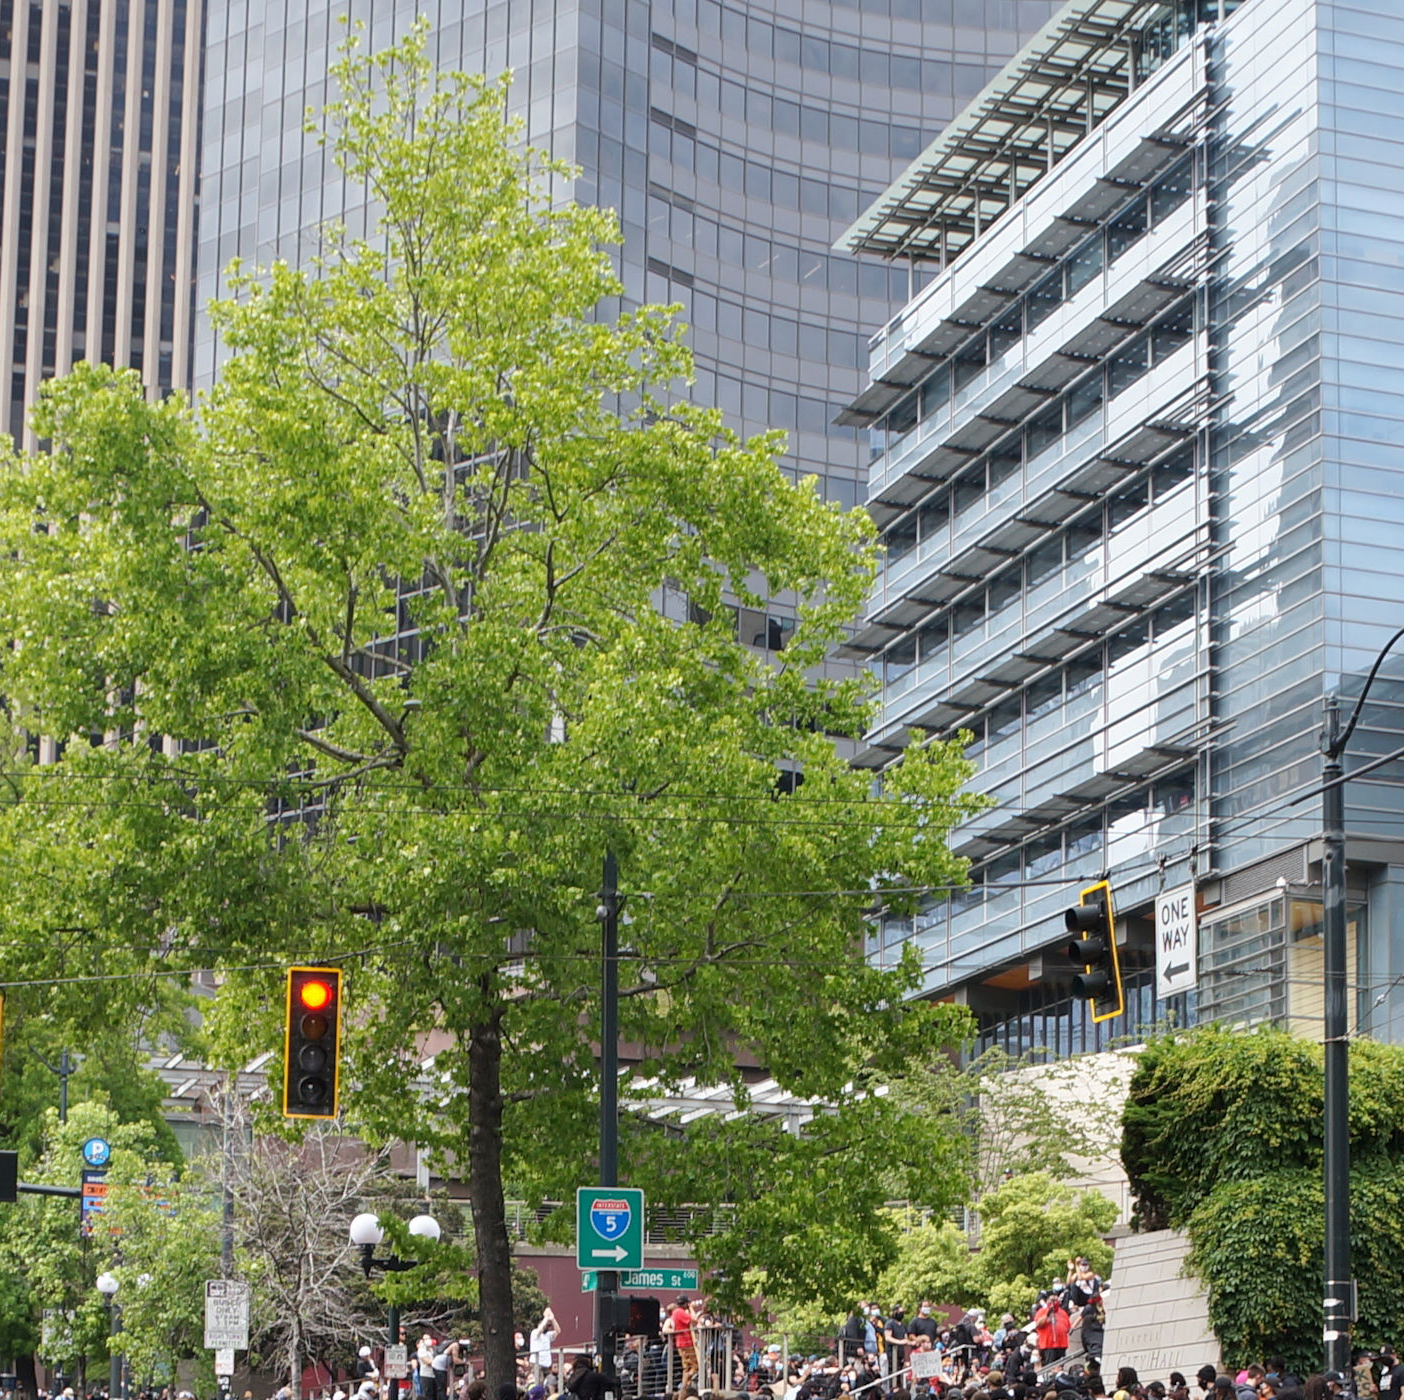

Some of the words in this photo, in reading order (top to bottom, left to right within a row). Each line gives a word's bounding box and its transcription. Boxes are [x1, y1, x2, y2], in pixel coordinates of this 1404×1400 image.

[1162, 897, 1189, 926] ONE
[1162, 923, 1190, 953] WAY
[605, 1216, 617, 1232] 5
[624, 1270, 664, 1287] James
[671, 1276, 682, 1287] St
